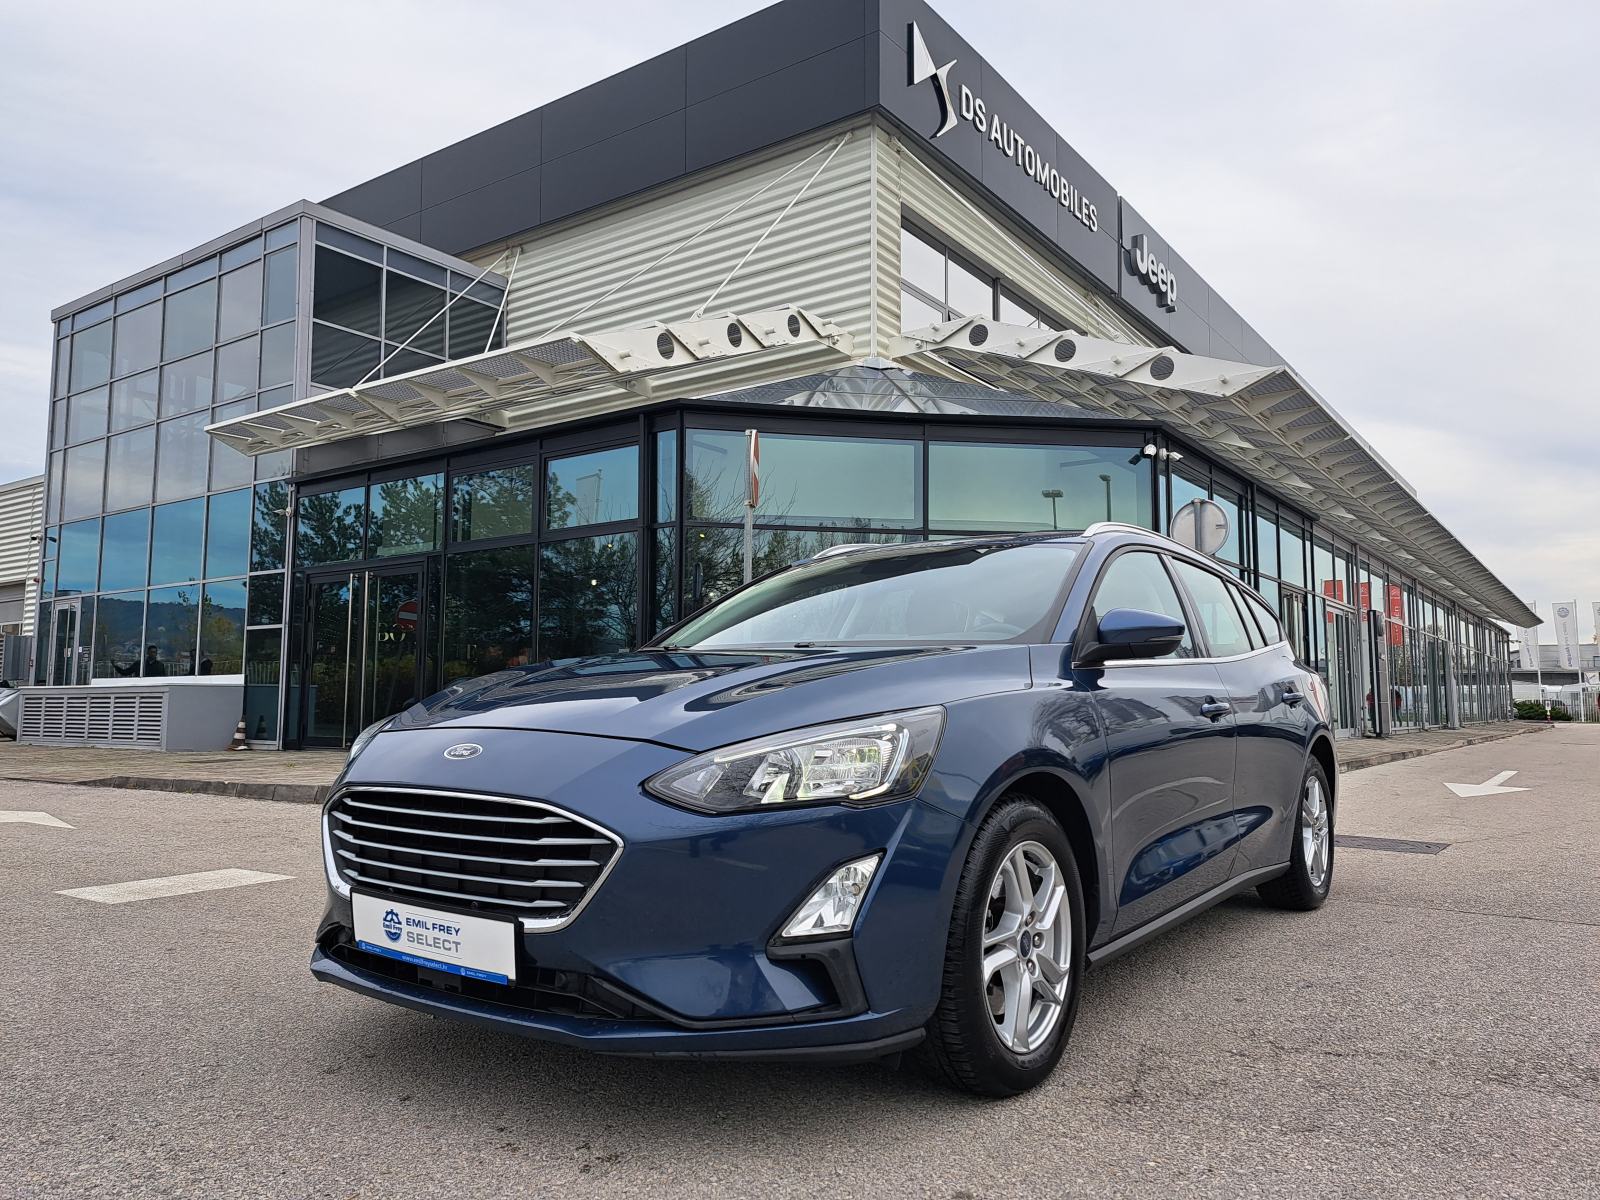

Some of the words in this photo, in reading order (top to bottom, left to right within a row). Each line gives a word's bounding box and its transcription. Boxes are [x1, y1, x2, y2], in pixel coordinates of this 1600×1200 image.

[961, 84, 987, 133] DS
[990, 114, 1099, 233] AUTOMOBILES
[1133, 233, 1177, 307] Jeep
[405, 917, 431, 931] EMIL
[432, 922, 461, 936] FREY
[406, 930, 462, 954] SELECT
